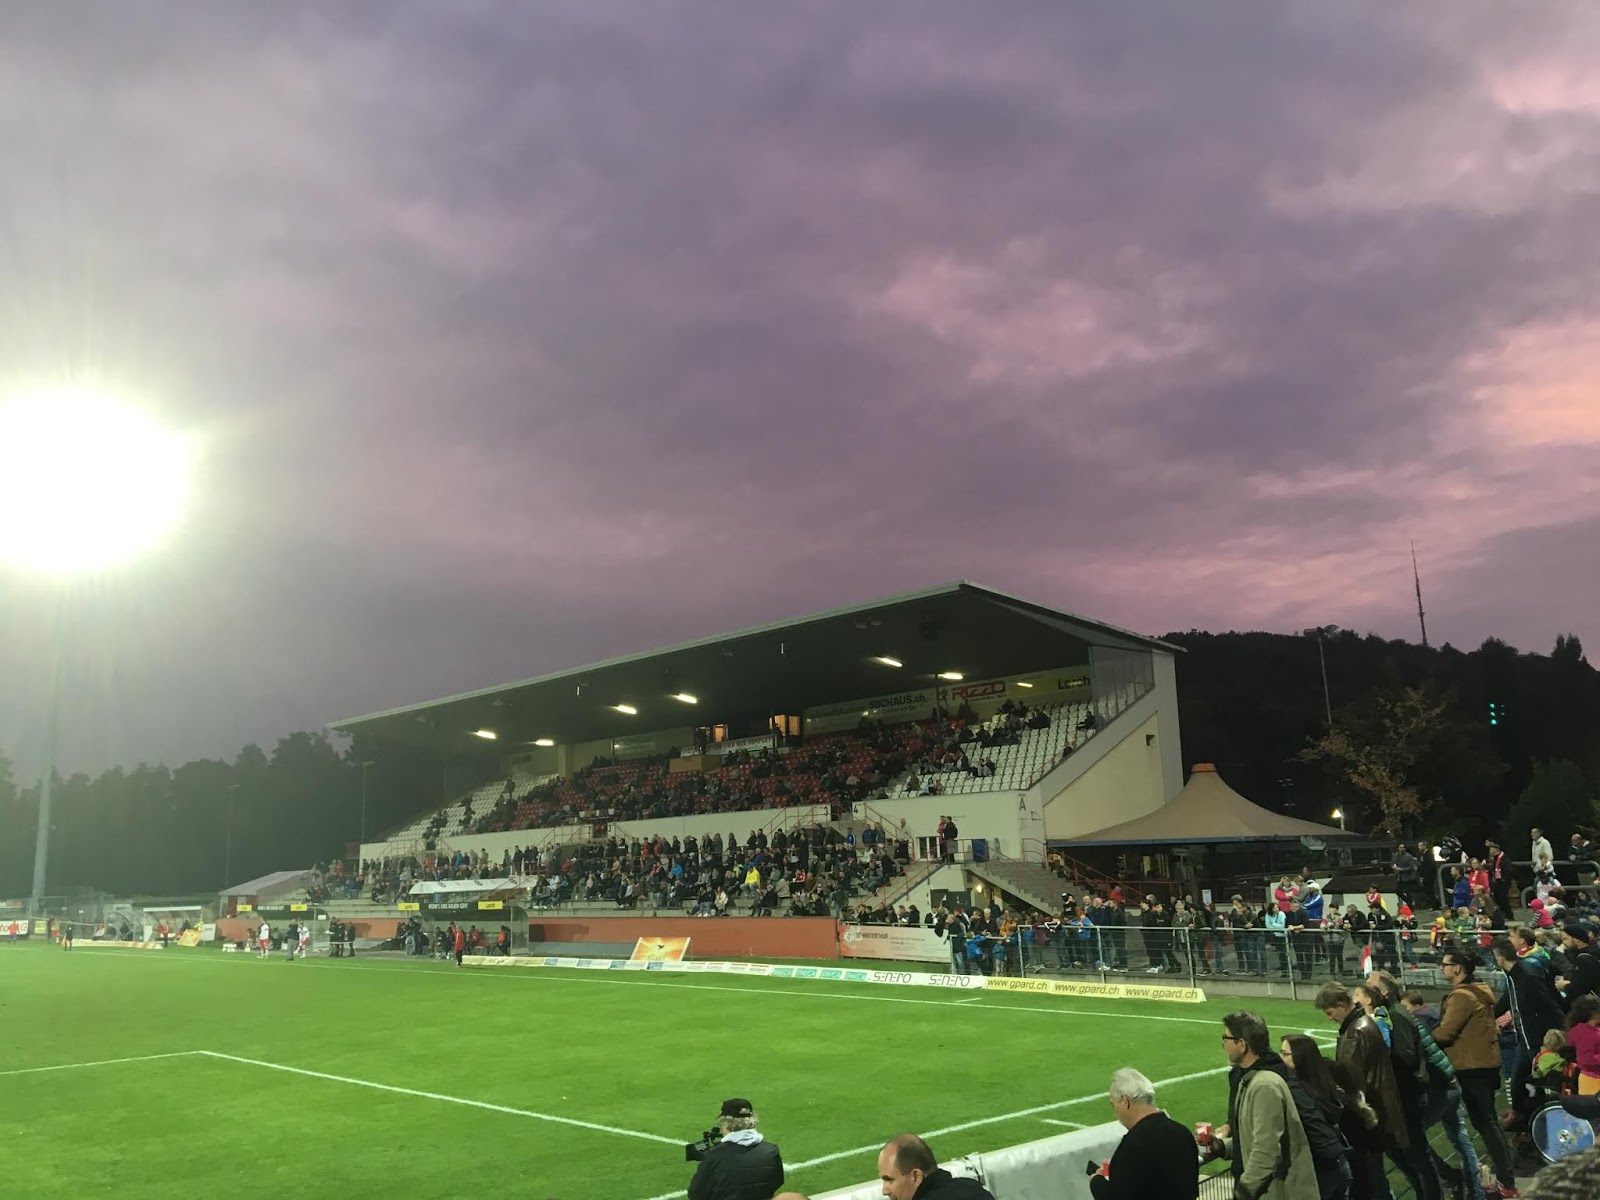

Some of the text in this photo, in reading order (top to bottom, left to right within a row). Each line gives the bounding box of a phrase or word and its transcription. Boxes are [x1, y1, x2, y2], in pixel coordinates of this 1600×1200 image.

[1019, 797, 1027, 811] A
[1054, 983, 1120, 995] www.gpard.ch
[1125, 987, 1198, 1000] www.gpard.ch
